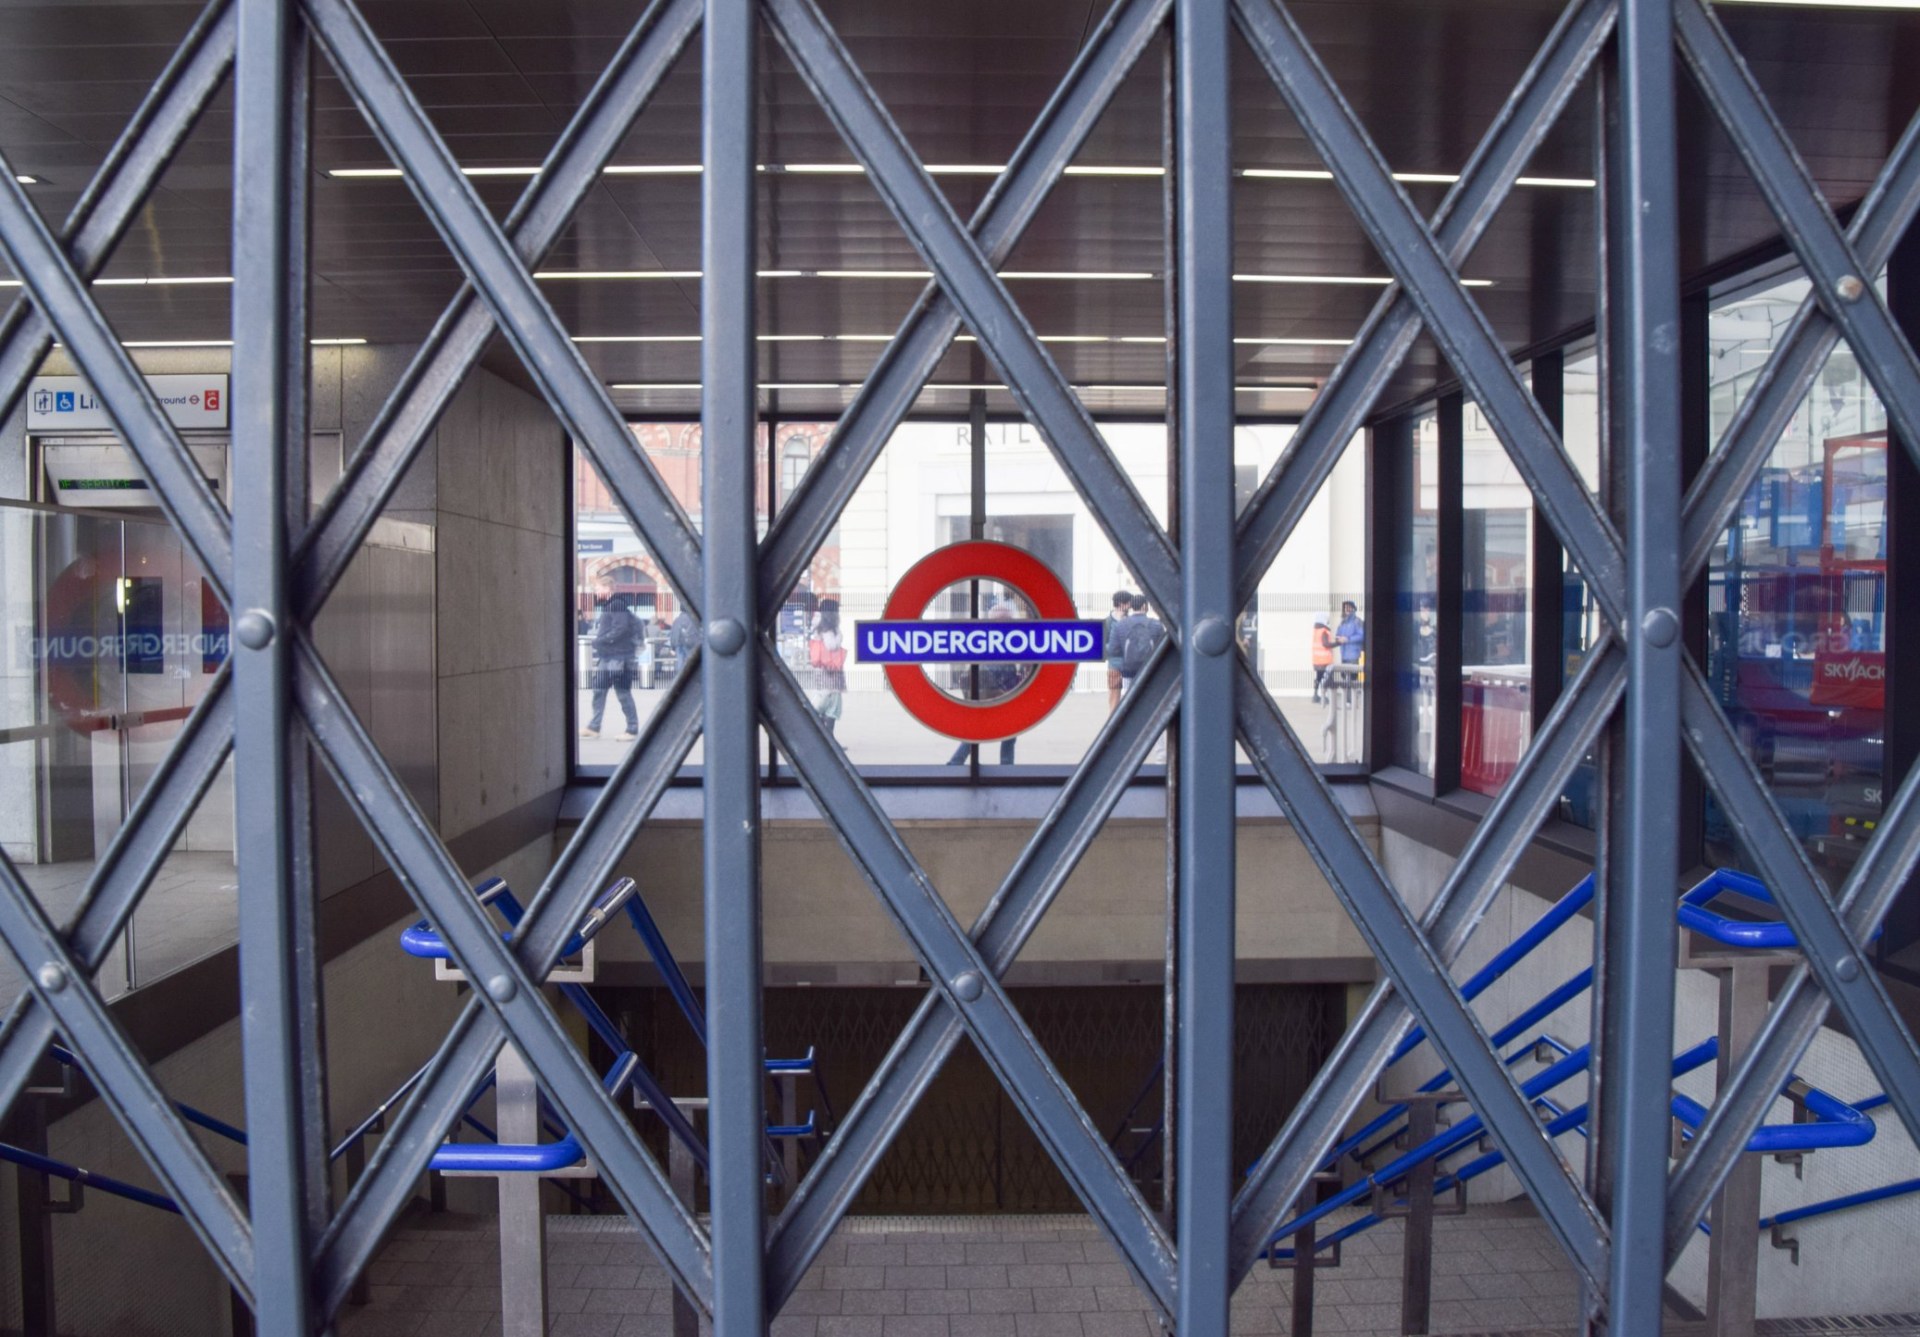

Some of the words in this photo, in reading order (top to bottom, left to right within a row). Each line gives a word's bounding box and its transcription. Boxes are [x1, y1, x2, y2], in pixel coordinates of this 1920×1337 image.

[160, 396, 187, 405] round
[207, 396, 217, 409] C
[957, 422, 1031, 446] RIL
[867, 630, 1094, 654] UNDERGROUND
[1823, 657, 1885, 681] SKYJACK
